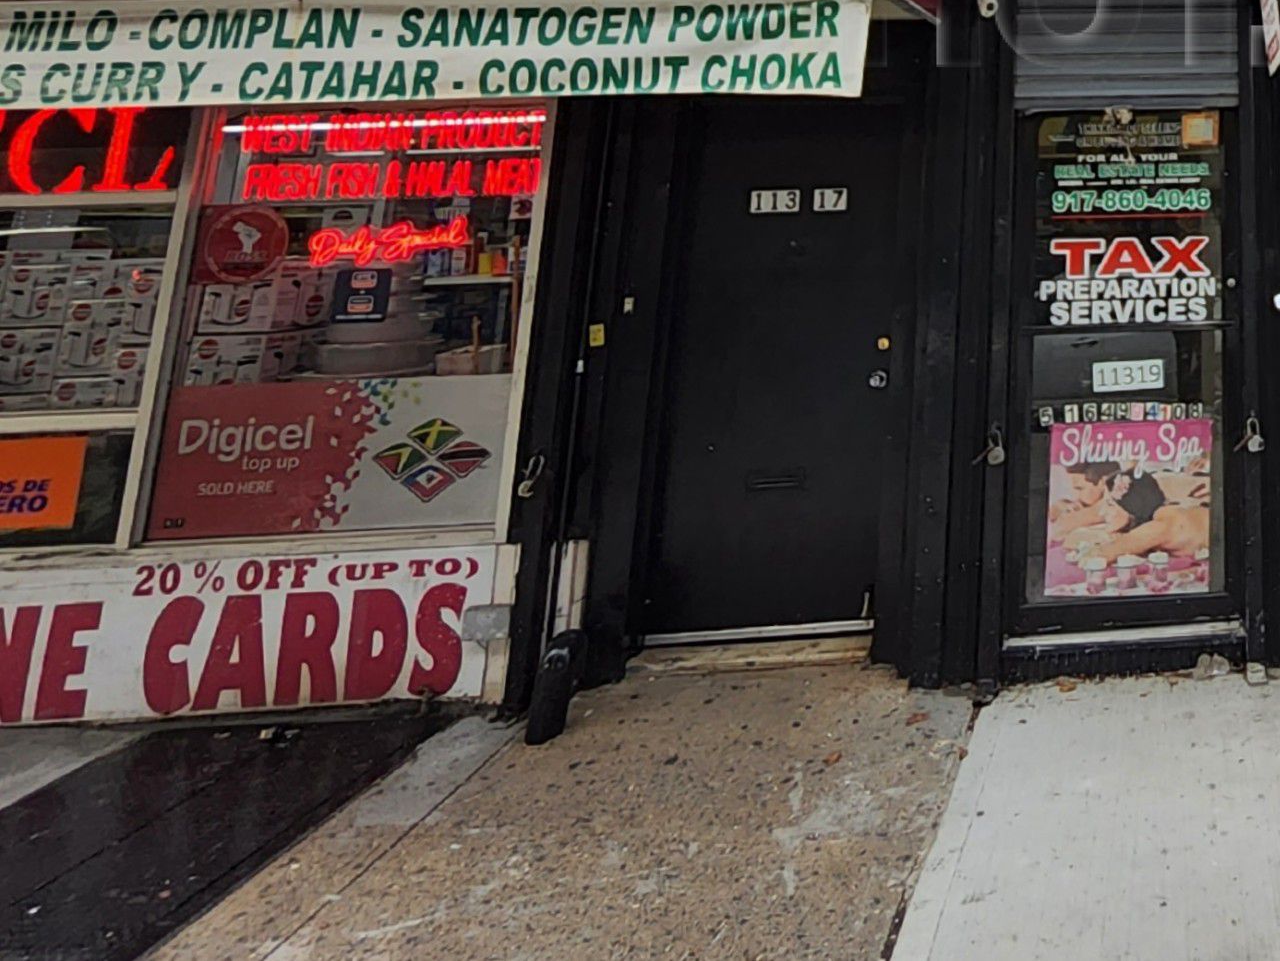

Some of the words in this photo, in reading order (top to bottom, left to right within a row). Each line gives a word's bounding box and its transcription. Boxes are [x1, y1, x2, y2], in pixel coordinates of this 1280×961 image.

[4, 9, 118, 52] MILO
[148, 8, 360, 50] COMPLAN
[397, 6, 655, 49] SANATOGEN
[668, 0, 840, 43] POWDER
[40, 61, 207, 103] CURRY
[238, 60, 440, 102] CATAHAR
[479, 56, 689, 96] COCONUT
[701, 52, 842, 91] CHOKA
[241, 114, 318, 154] WEST
[325, 111, 414, 152] INDIAN
[420, 109, 547, 150] PRODUCT
[1077, 154, 1106, 163] FOR
[1140, 152, 1178, 162] YOUR
[243, 163, 321, 201] FRESH
[325, 161, 380, 200] FISH
[382, 159, 402, 199] &
[405, 158, 476, 199] HALAL
[483, 156, 542, 196] MEAT
[754, 191, 797, 211] 113
[817, 190, 844, 209] 17
[1052, 189, 1211, 212] 917-860-4046
[309, 225, 377, 268] Daily
[381, 214, 469, 264] Special
[1050, 236, 1211, 279] TAX
[1039, 277, 1216, 301] PREPARATION
[1050, 298, 1207, 326] SERVICES
[1097, 364, 1161, 387] 11319
[178, 416, 314, 462] Digicel
[1059, 424, 1151, 479] Shining
[1157, 423, 1204, 472] Spa
[242, 453, 271, 474] top
[276, 454, 300, 473] up
[197, 480, 233, 495] SOLD
[237, 479, 275, 494] HERE
[236, 558, 317, 590] OFF
[328, 560, 399, 587] (UP
[410, 557, 479, 581] TO)
[143, 582, 469, 715] CARDS
